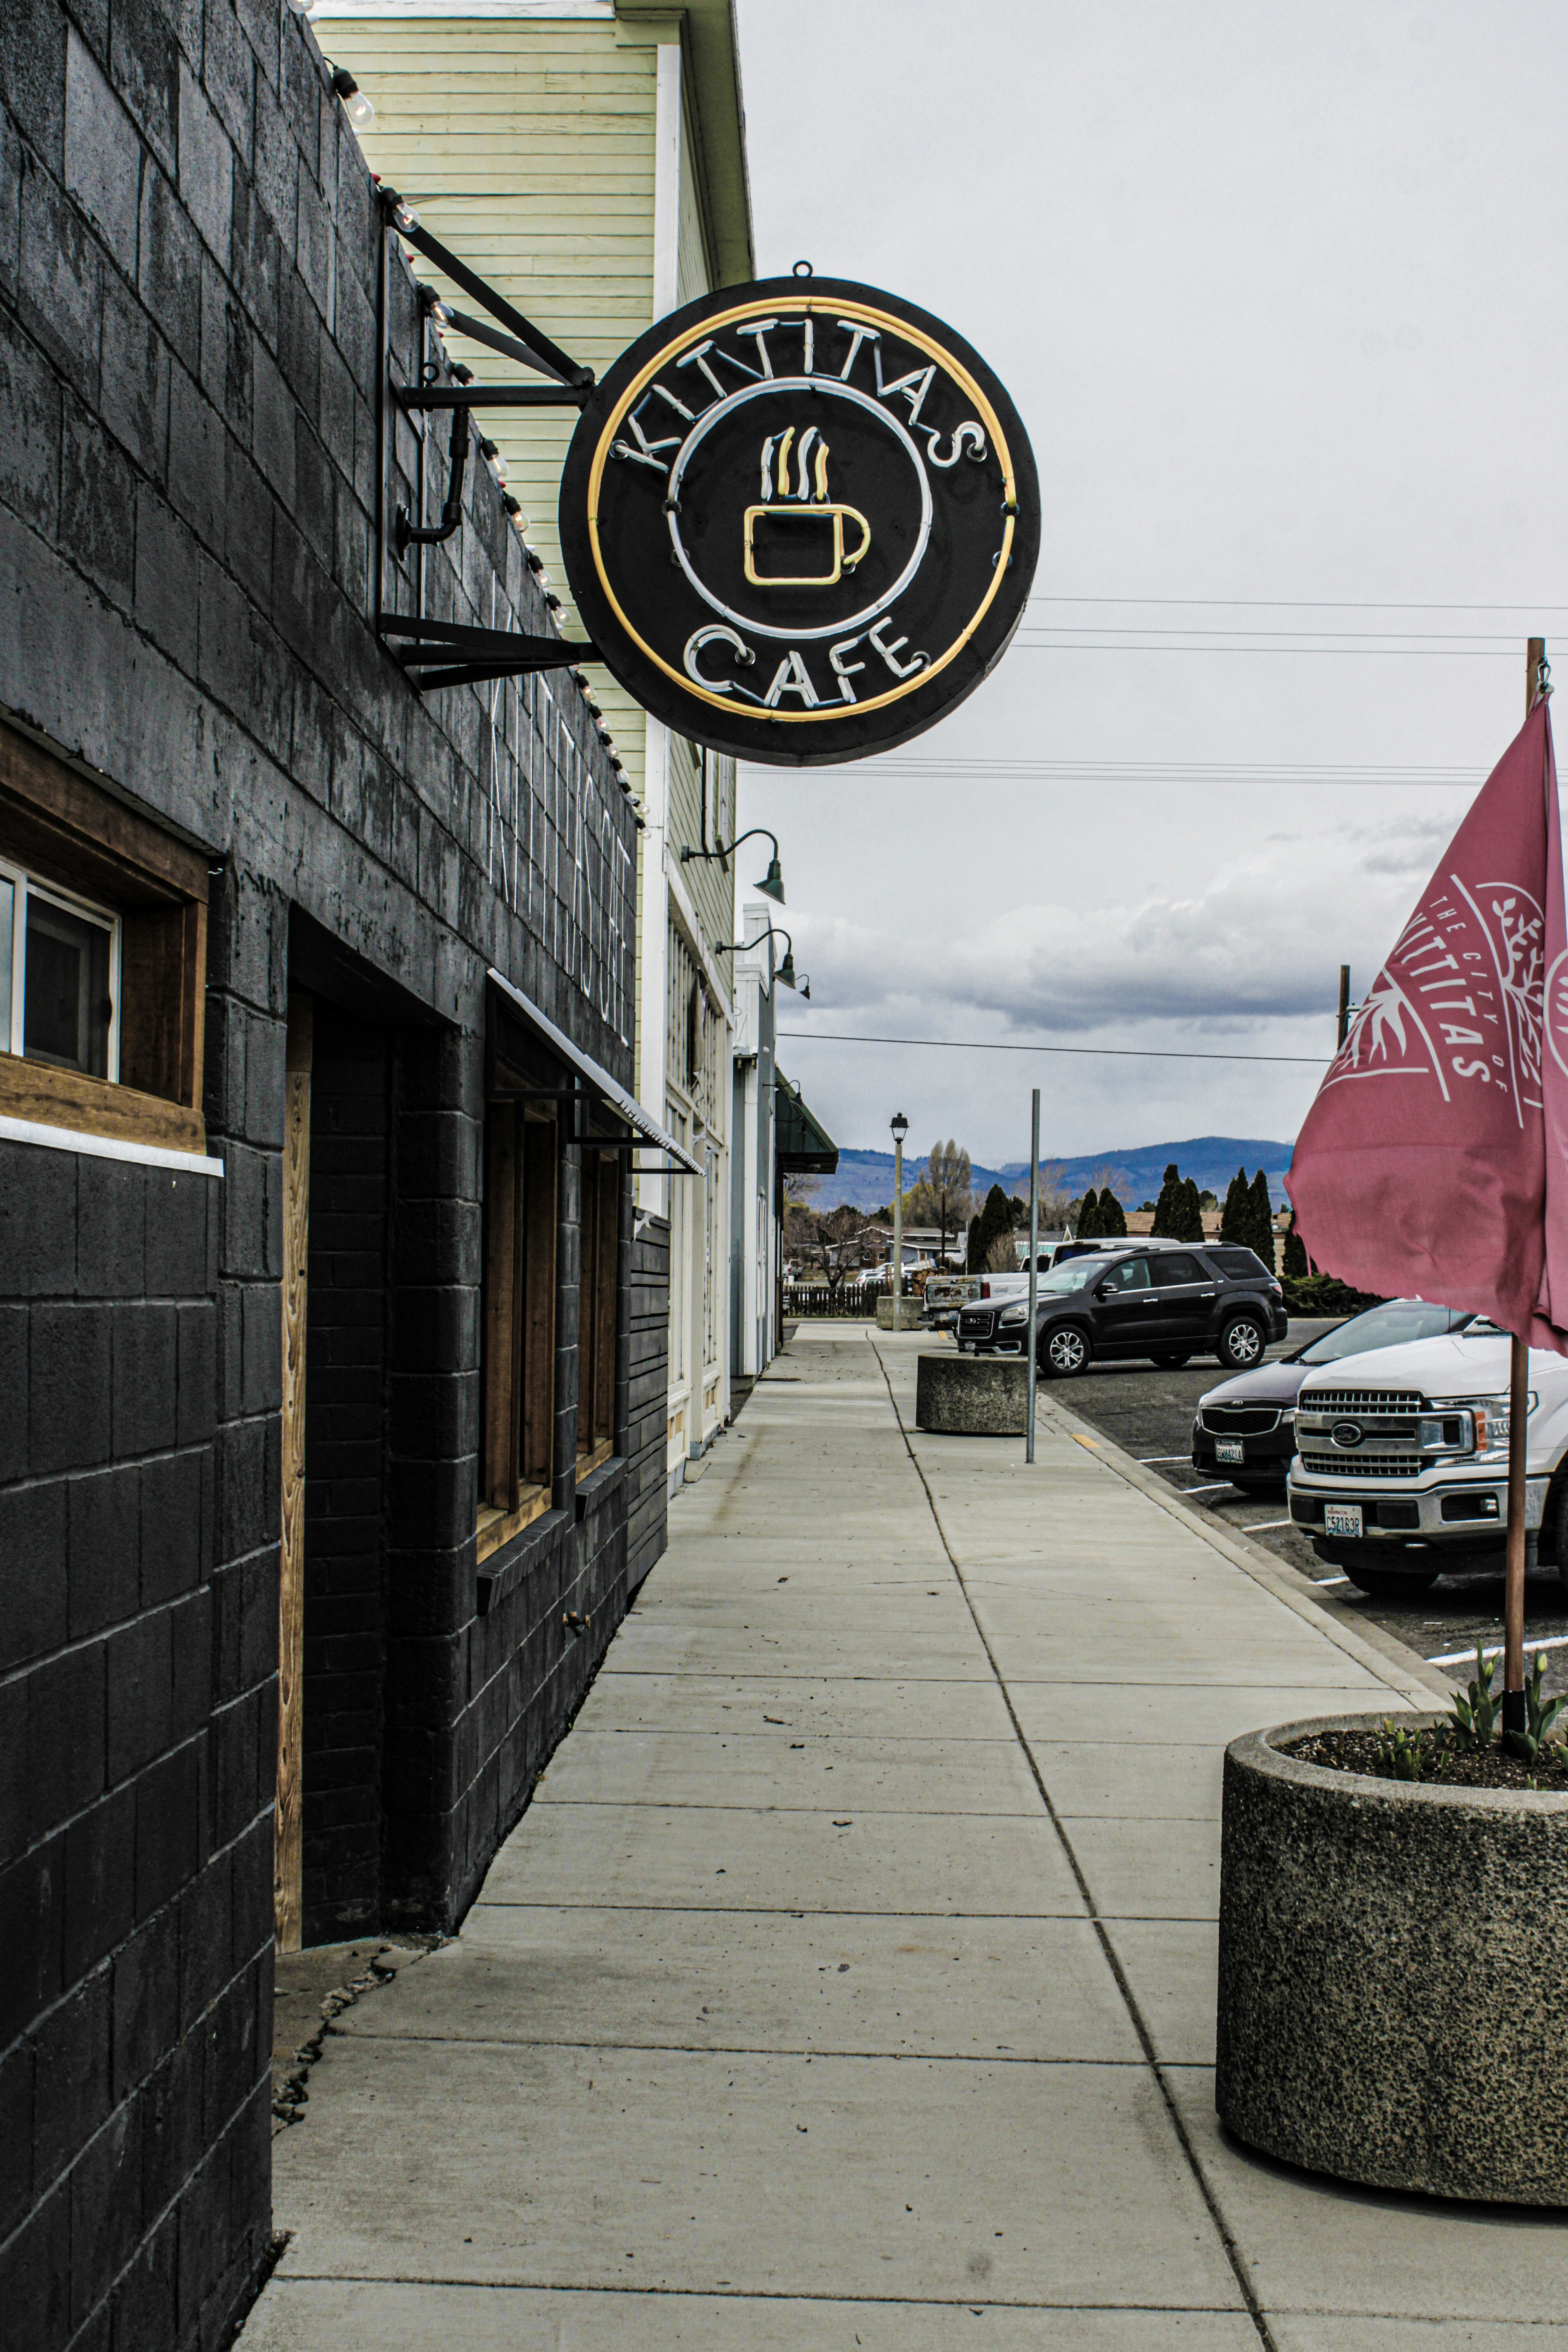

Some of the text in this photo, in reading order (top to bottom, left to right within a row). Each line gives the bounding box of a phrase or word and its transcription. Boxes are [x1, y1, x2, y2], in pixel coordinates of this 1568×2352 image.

[616, 319, 985, 472] KITTITAS
[684, 617, 924, 708] CAFE
[1430, 896, 1508, 1093] THE CITY OF
[1327, 1516, 1359, 1534] C52163R
